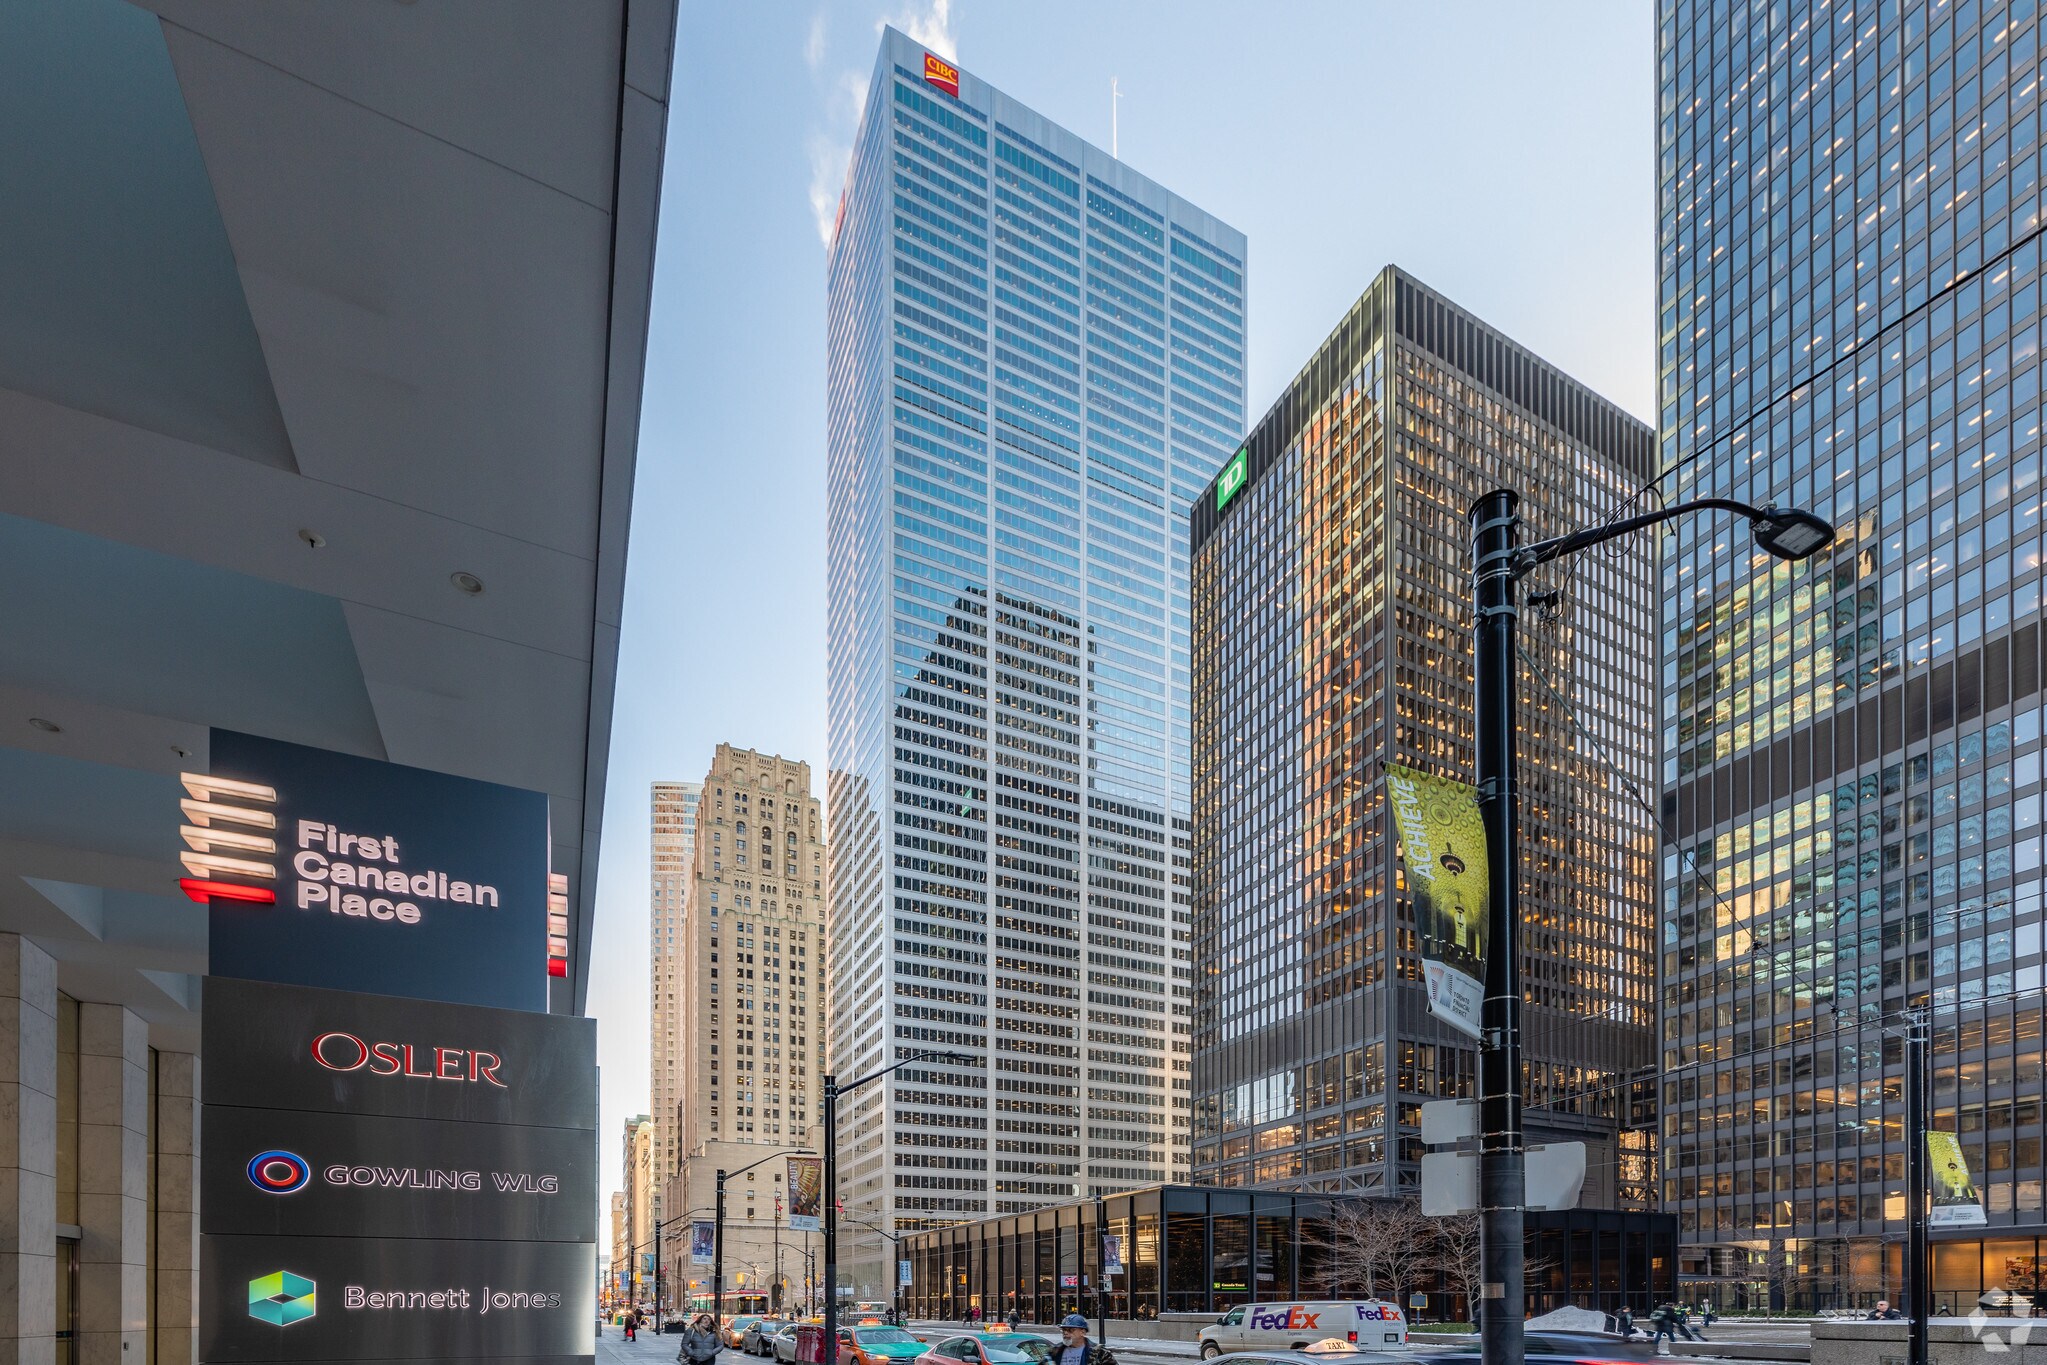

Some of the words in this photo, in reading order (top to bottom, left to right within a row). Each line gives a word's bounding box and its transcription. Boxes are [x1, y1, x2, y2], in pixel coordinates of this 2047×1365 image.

[927, 57, 957, 82] CIBC
[1220, 461, 1243, 497] TD
[298, 819, 399, 863] First
[1392, 776, 1436, 881] ACHIEVE
[293, 850, 499, 908] Canadian
[297, 880, 422, 924] Place
[311, 1032, 508, 1088] OSLER
[323, 1164, 481, 1191] GOWLING
[491, 1172, 559, 1194] WLG
[789, 1160, 799, 1190] BEAUTY
[344, 1286, 470, 1309] Bennett
[479, 1286, 562, 1315] Jones
[1355, 1305, 1401, 1321] FedEx
[1250, 1305, 1321, 1331] FedEx
[1326, 1342, 1346, 1350] TAXI
